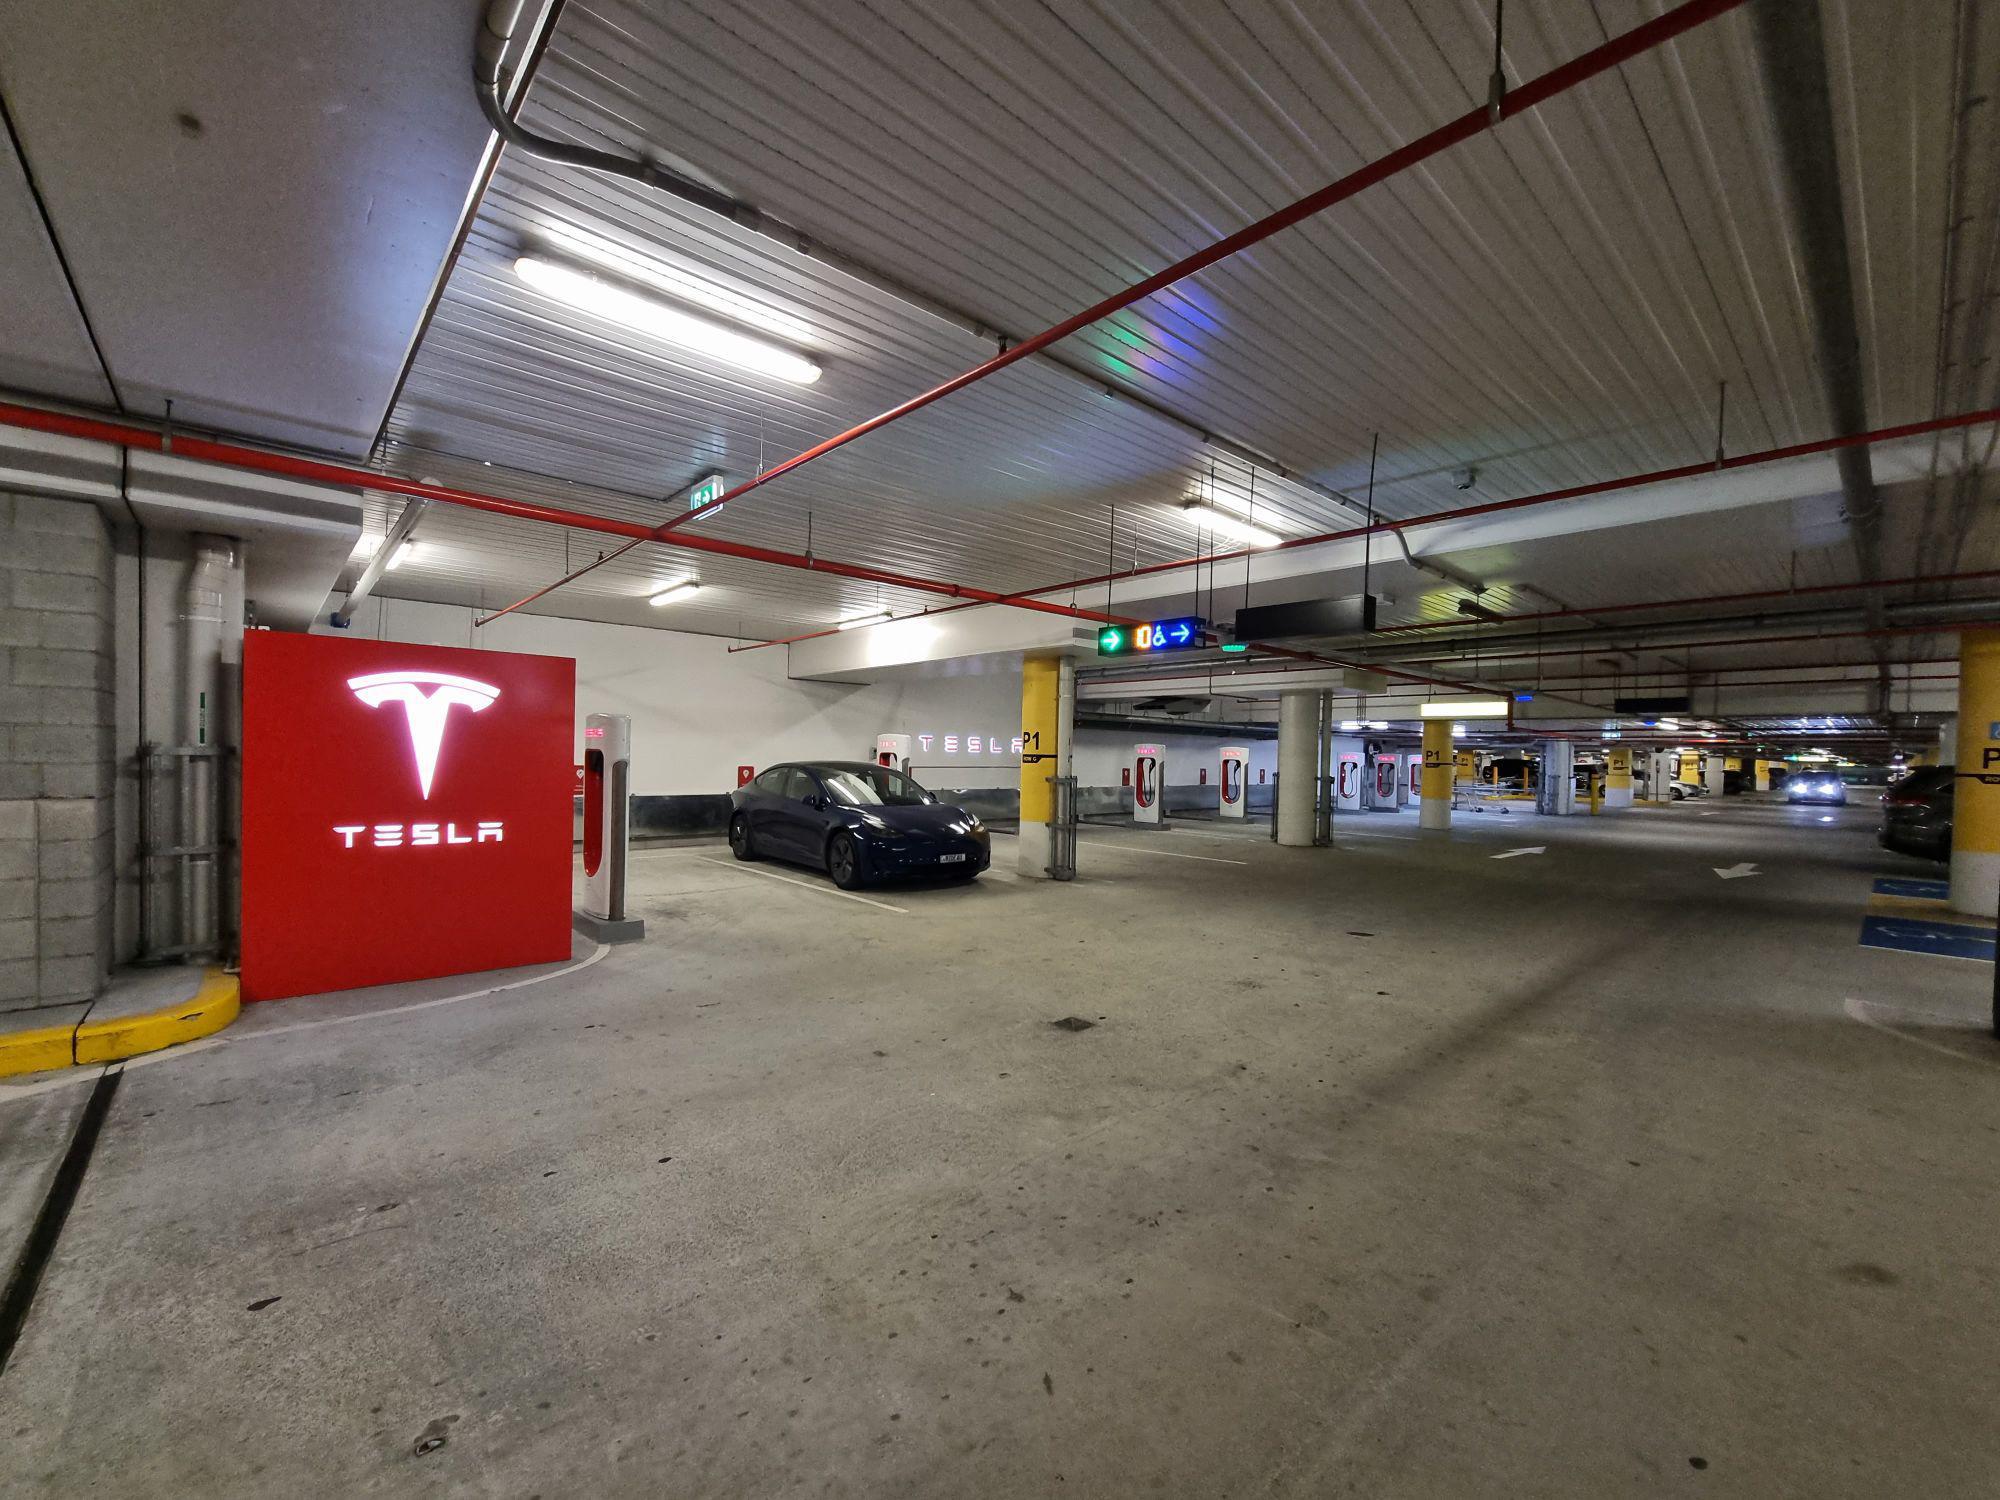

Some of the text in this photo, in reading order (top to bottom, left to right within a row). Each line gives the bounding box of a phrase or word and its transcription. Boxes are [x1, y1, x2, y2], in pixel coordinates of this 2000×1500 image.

[918, 734, 1022, 754] TESLA
[1023, 731, 1040, 750] P1
[1425, 750, 1440, 761] P1
[332, 822, 503, 848] TESLA
